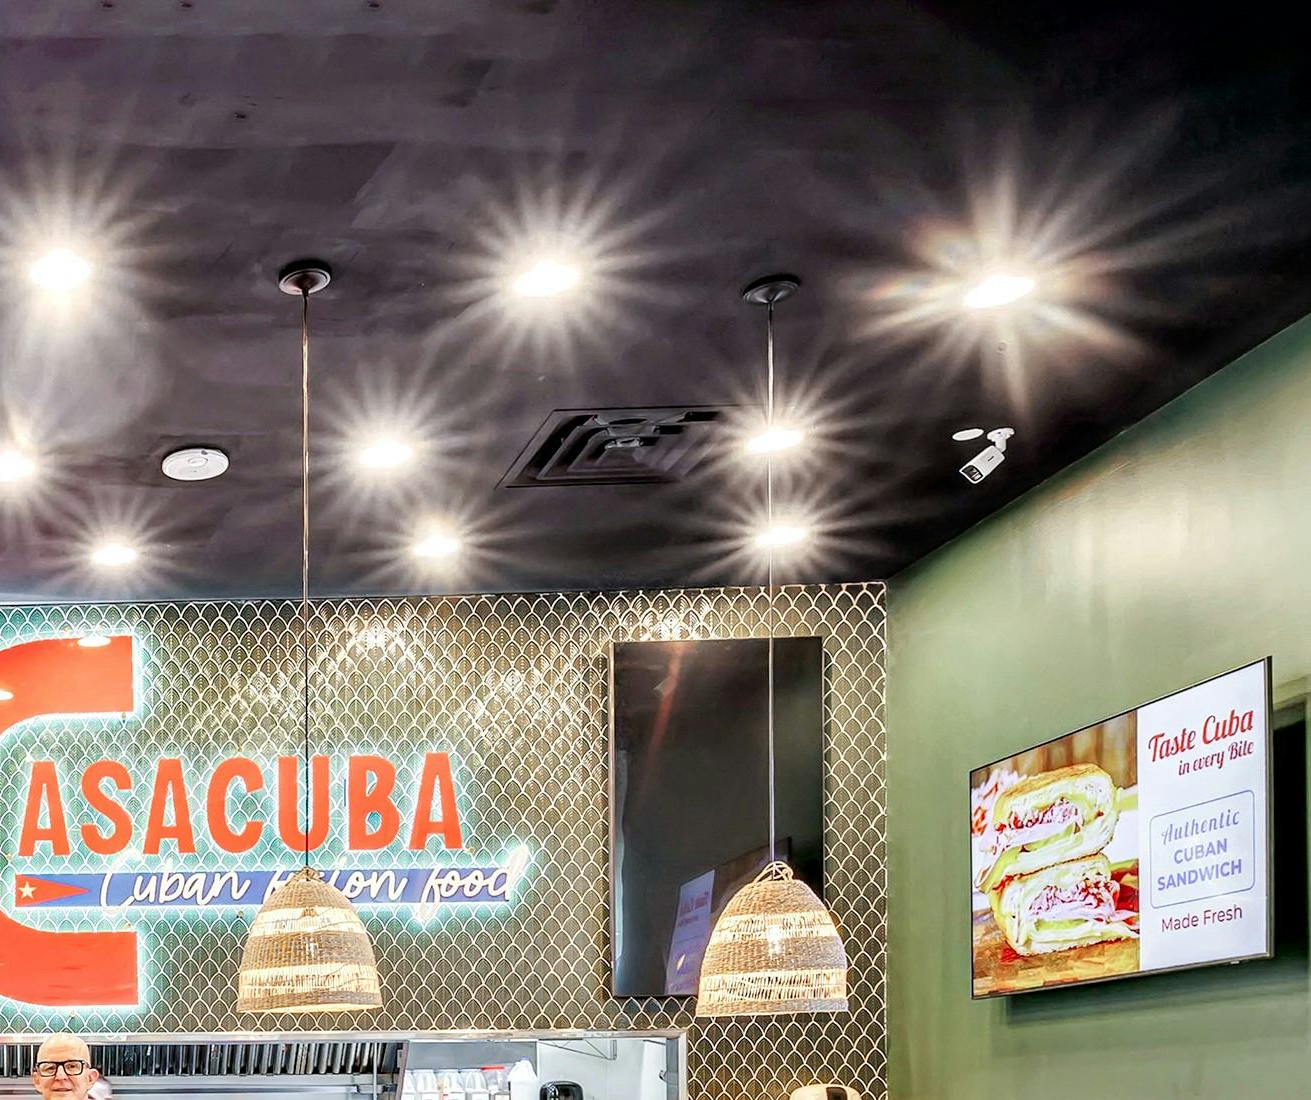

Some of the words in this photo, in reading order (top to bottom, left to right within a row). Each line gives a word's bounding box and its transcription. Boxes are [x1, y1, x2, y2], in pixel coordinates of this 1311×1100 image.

[1148, 727, 1197, 763] Taste
[1202, 708, 1254, 745] Cuba
[1178, 759, 1191, 776] in
[1193, 750, 1225, 772] every
[1228, 739, 1254, 761] Bite
[1161, 808, 1240, 845] Authentic
[1174, 838, 1228, 864] CUBAN
[100, 852, 251, 916] Cuban
[263, 856, 408, 906] fion
[416, 844, 530, 924] food
[1157, 859, 1242, 891] SANDWICH
[1161, 913, 1200, 933] Made
[1203, 903, 1243, 924] Fresh
